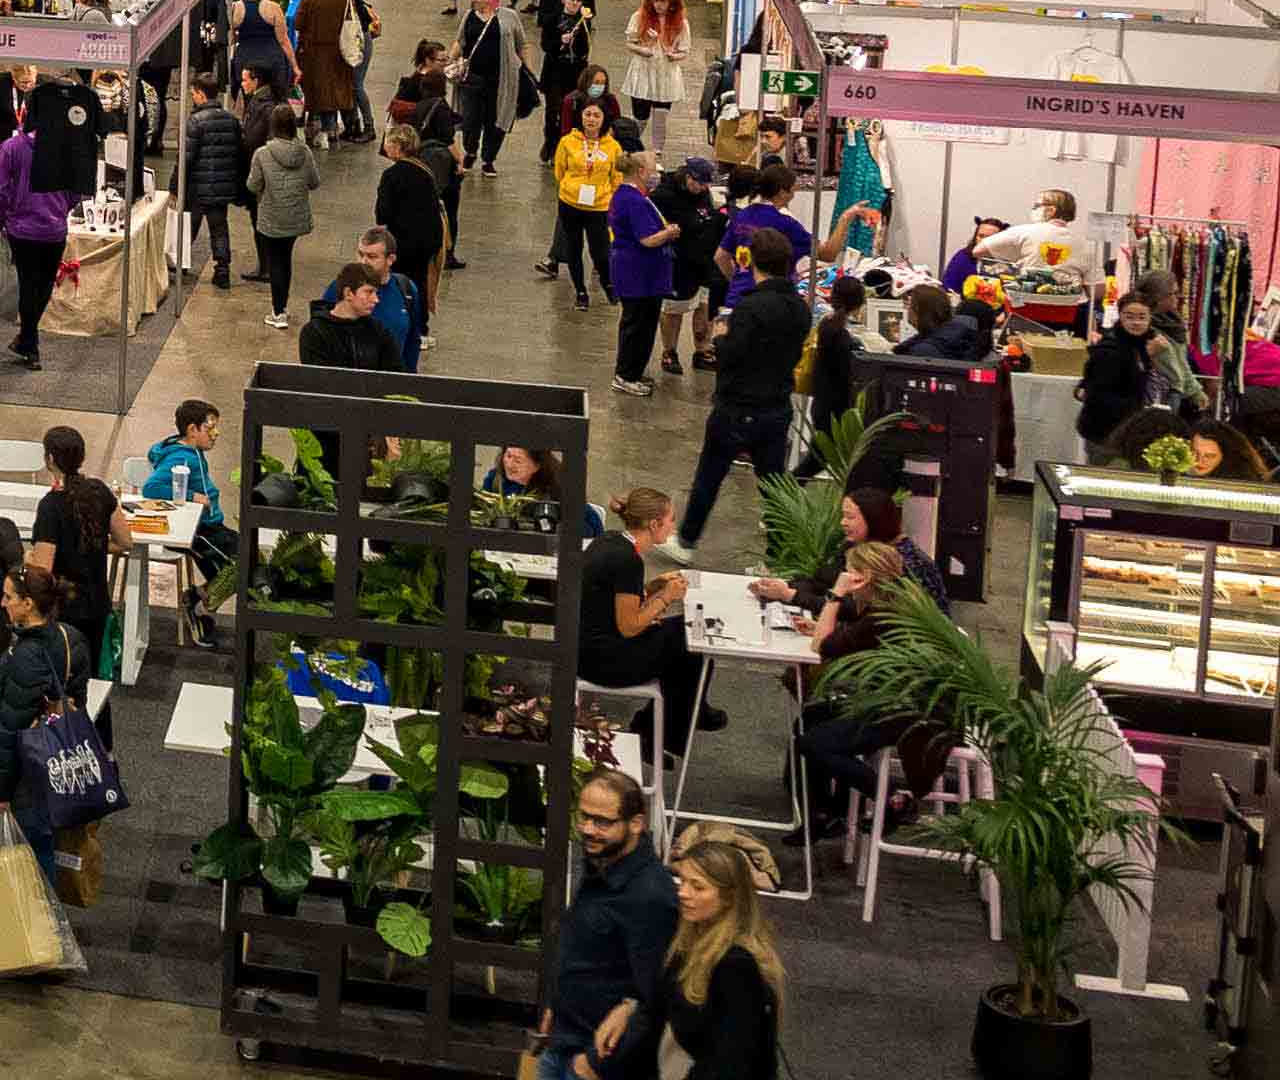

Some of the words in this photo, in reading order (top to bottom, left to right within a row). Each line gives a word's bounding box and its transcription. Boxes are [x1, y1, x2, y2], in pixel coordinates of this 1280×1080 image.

[843, 84, 877, 100] 660
[1025, 94, 1111, 115] INGRID'S
[1116, 100, 1185, 120] HAVEN
